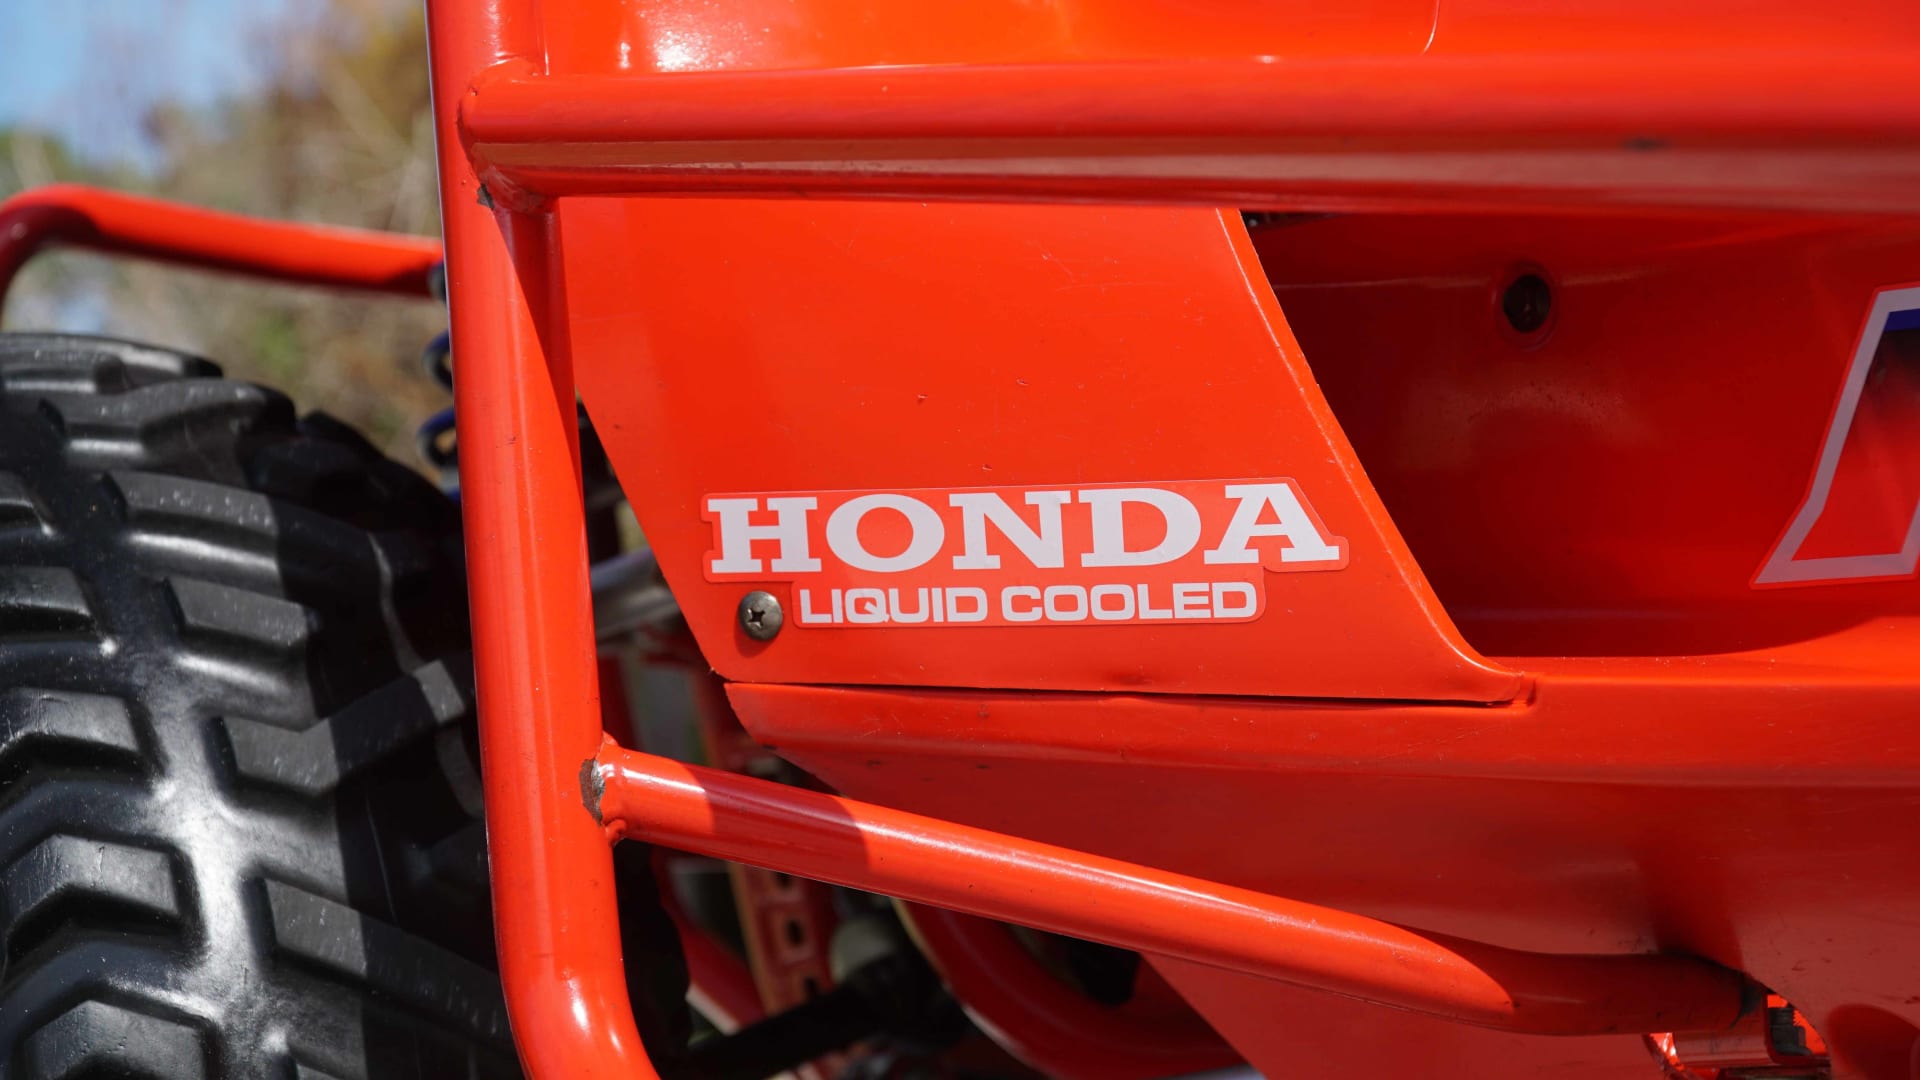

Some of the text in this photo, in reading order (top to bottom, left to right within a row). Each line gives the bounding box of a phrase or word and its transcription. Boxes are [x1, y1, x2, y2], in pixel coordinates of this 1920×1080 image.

[707, 481, 1341, 574] HONDA
[799, 581, 1258, 625] LIQUID COOLED
